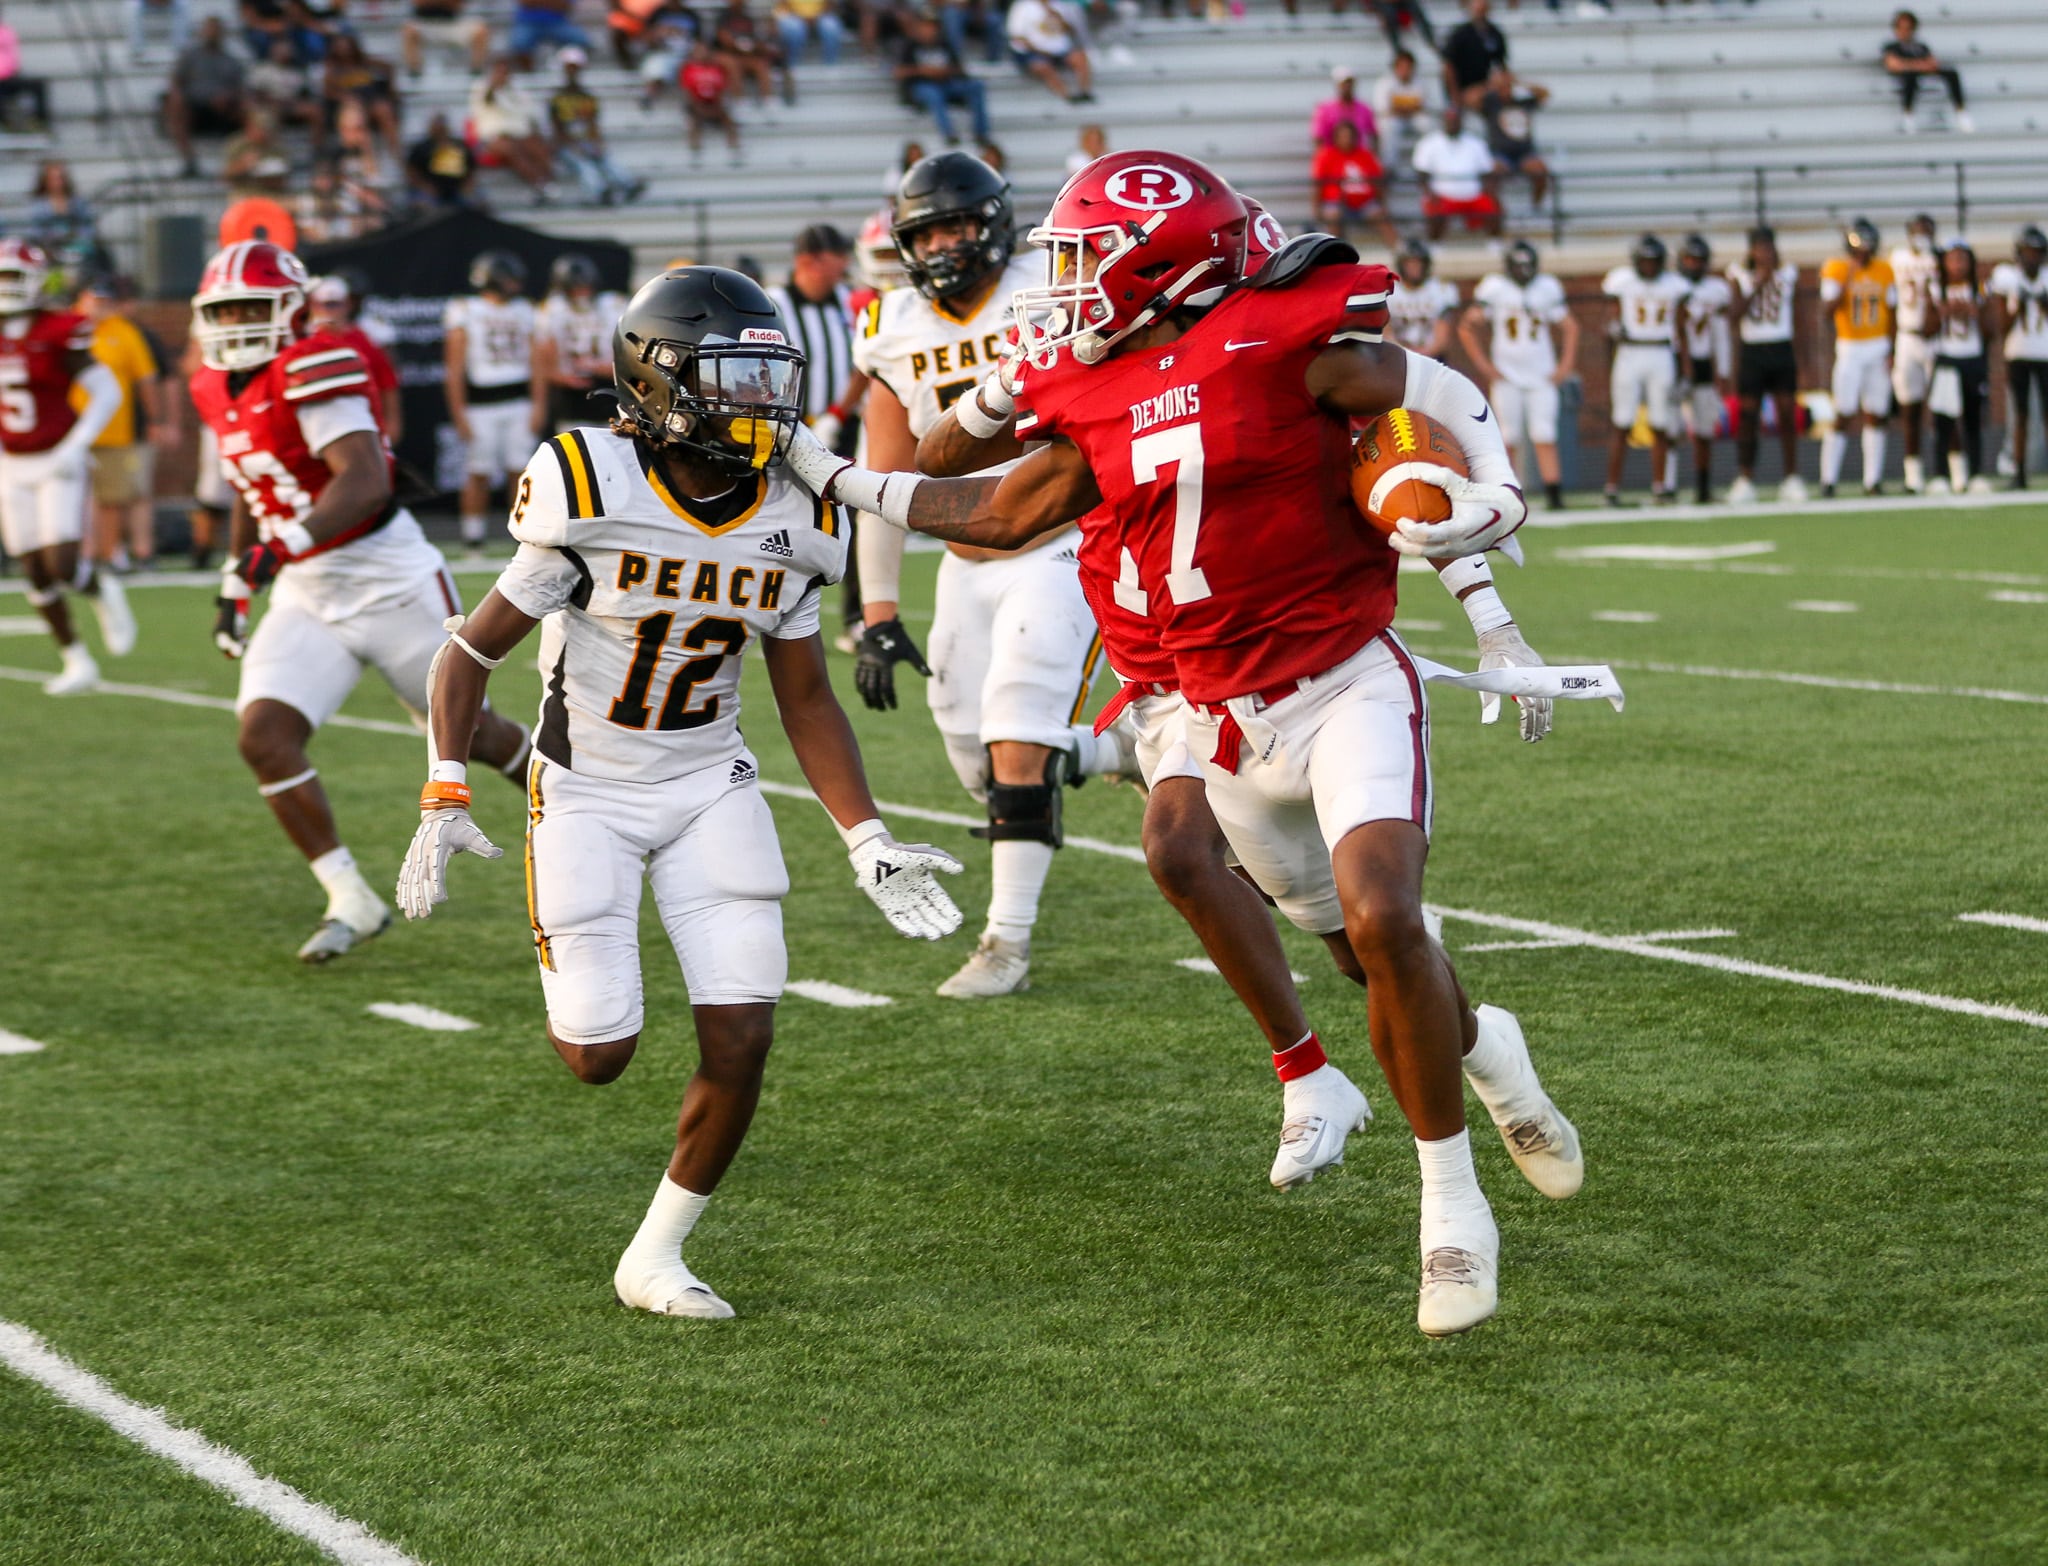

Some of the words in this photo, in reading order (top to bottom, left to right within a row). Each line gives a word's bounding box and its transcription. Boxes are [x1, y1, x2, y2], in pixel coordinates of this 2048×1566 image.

[1118, 169, 1181, 205] R
[1211, 232, 1219, 247] 7
[911, 328, 1011, 382] PEAC
[1129, 383, 1200, 434] DEMONS
[1131, 422, 1213, 606] 7
[760, 542, 793, 558] adidas
[617, 551, 787, 611] PEACH
[607, 610, 750, 731] 12
